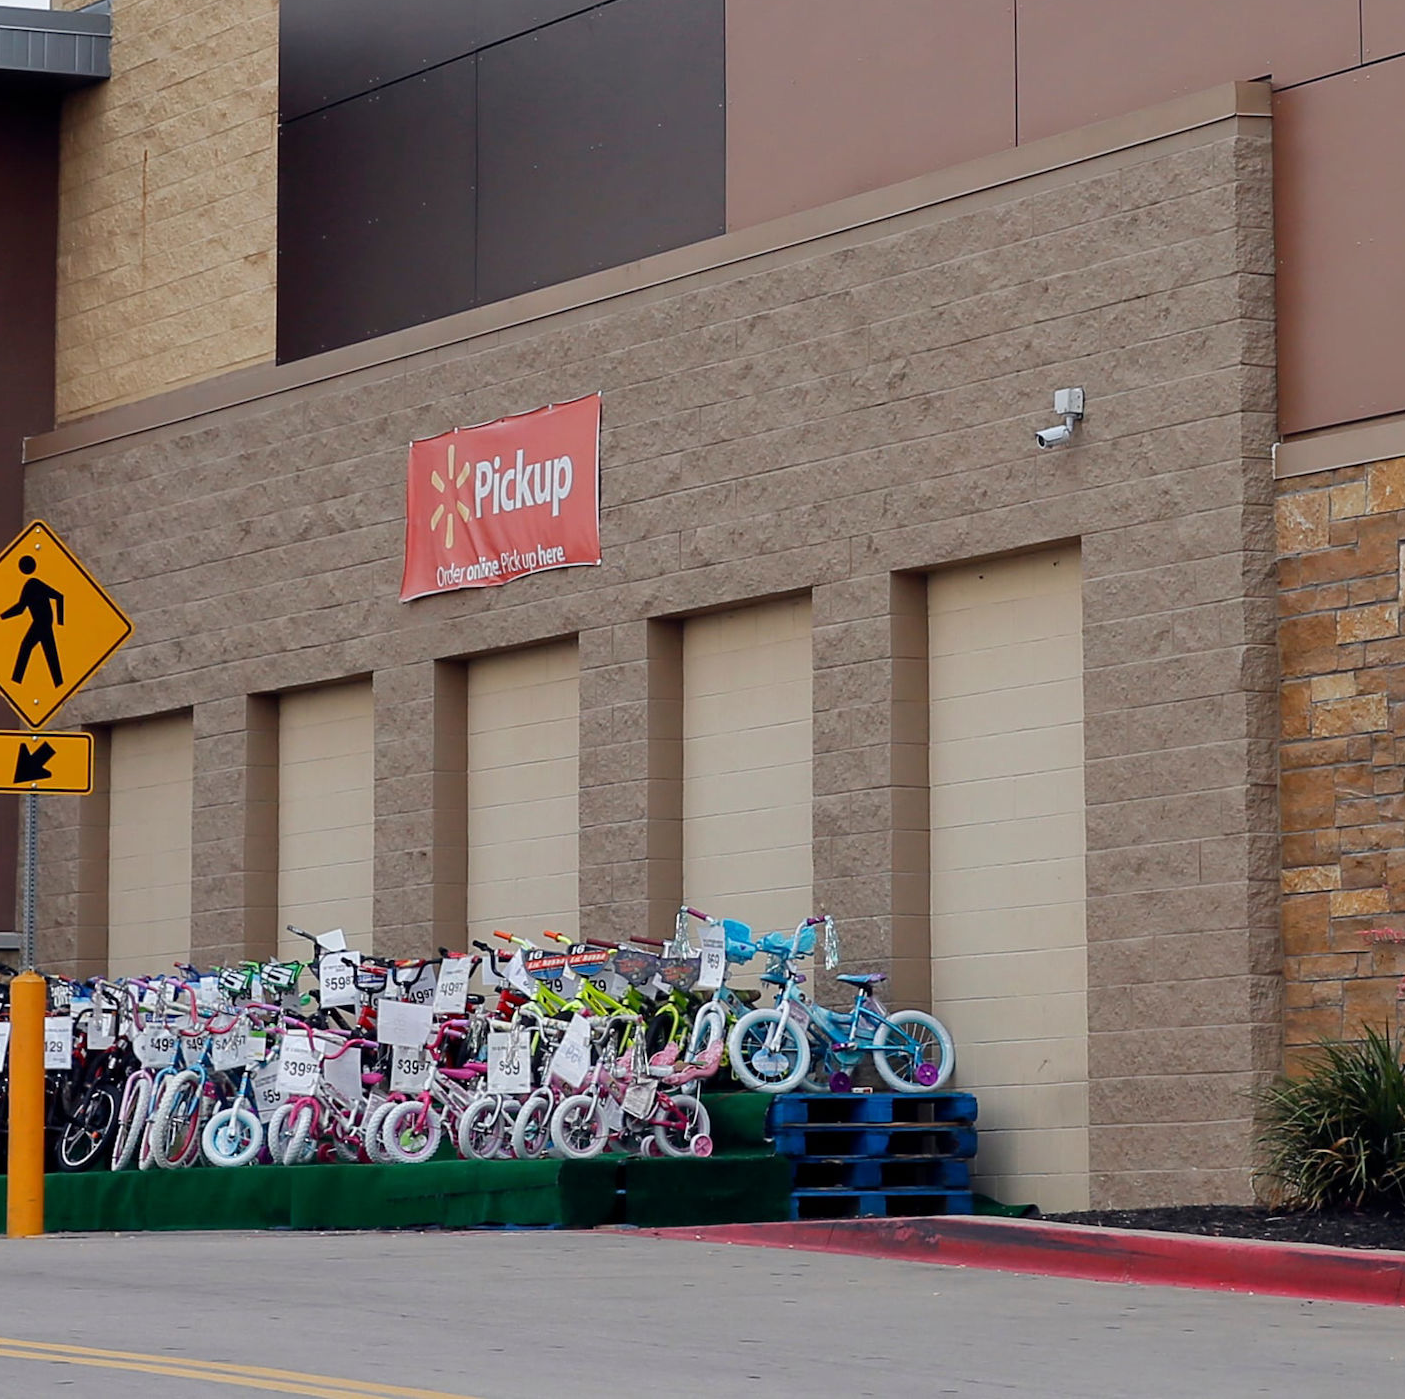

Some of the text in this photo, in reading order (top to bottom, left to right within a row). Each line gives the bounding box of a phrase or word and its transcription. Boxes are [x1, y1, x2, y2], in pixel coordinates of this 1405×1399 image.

[474, 448, 573, 519] Pickup
[436, 563, 465, 587] Order
[501, 549, 521, 574] Pick
[521, 553, 536, 573] up
